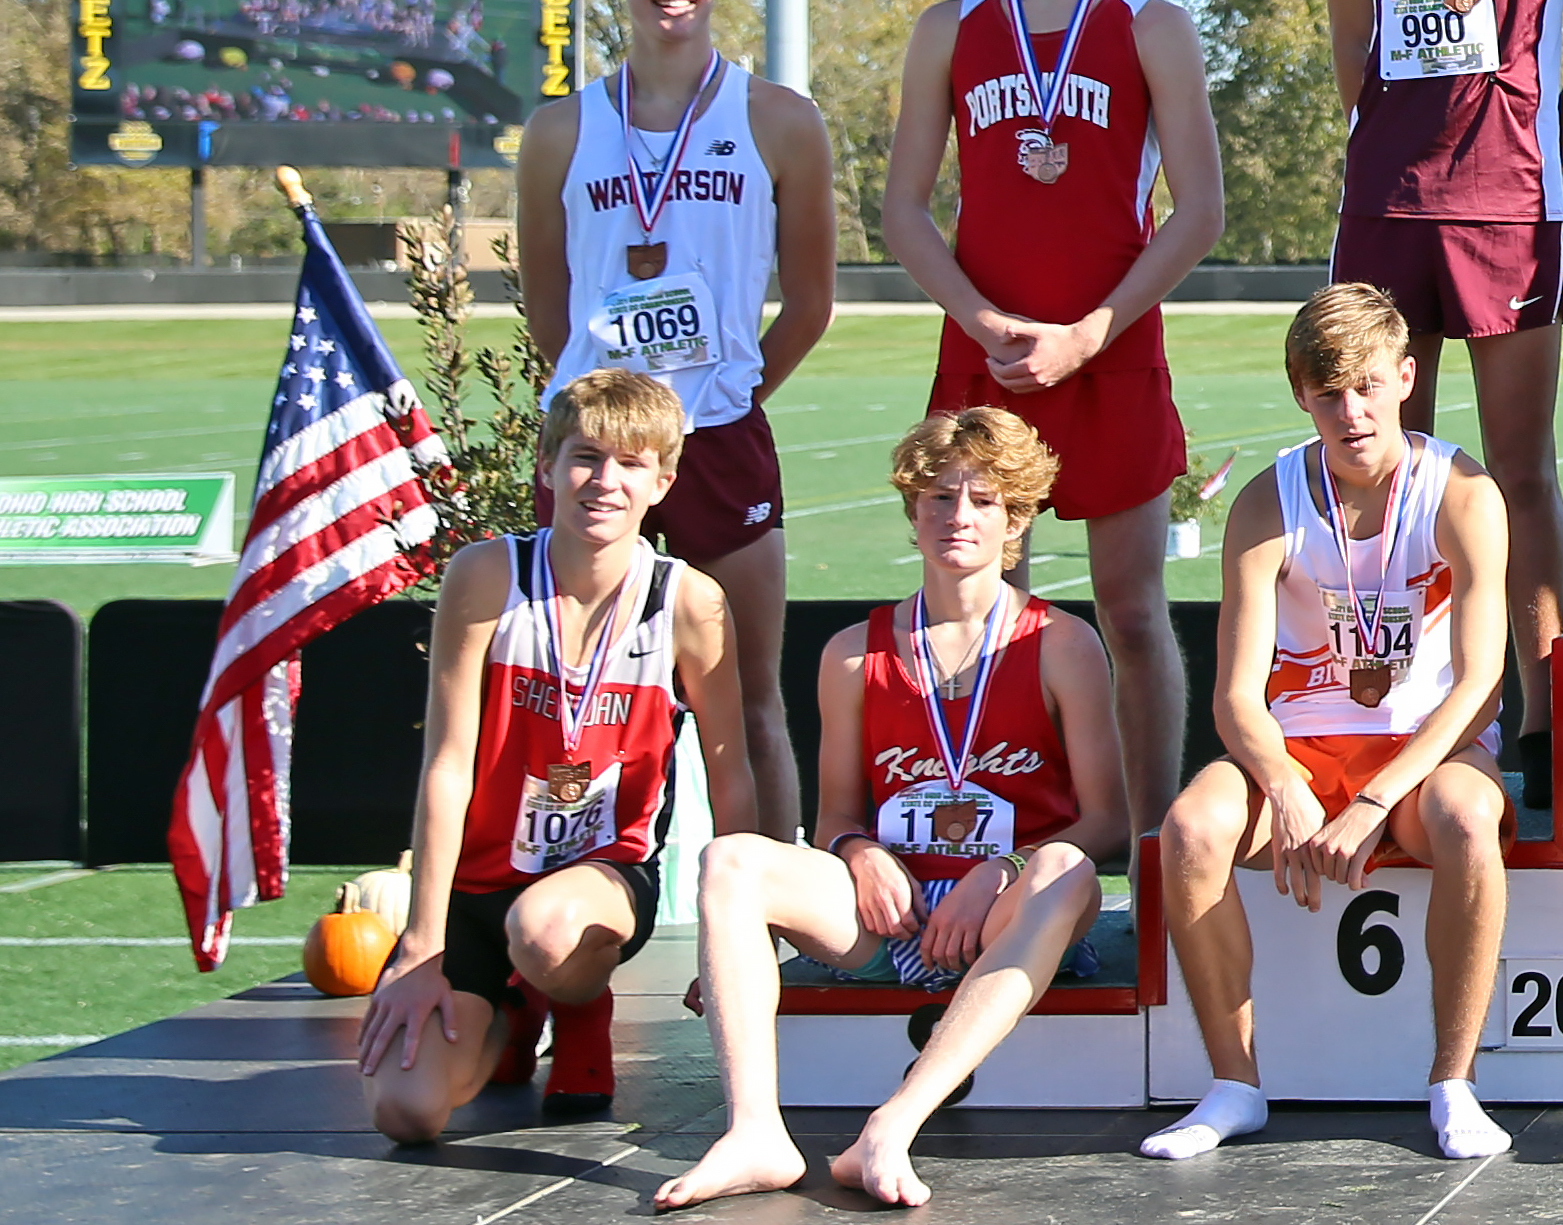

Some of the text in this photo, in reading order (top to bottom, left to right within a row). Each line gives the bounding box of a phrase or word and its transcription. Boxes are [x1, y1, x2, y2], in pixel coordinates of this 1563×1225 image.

[1402, 12, 1464, 48] 990
[1390, 49, 1413, 61] M-F
[586, 170, 746, 212] WATTRSON
[610, 304, 699, 347] 1069
[607, 335, 709, 360] M-F ATHLETIC
[0, 489, 188, 514] OHIO HIGH SCHOOL
[61, 514, 202, 537] ASSOCIATION
[1328, 622, 1414, 658] 1104
[525, 799, 604, 844] 1076
[901, 809, 994, 842] 117
[926, 843, 1000, 855] ATHLETIC
[1337, 889, 1405, 996] 6
